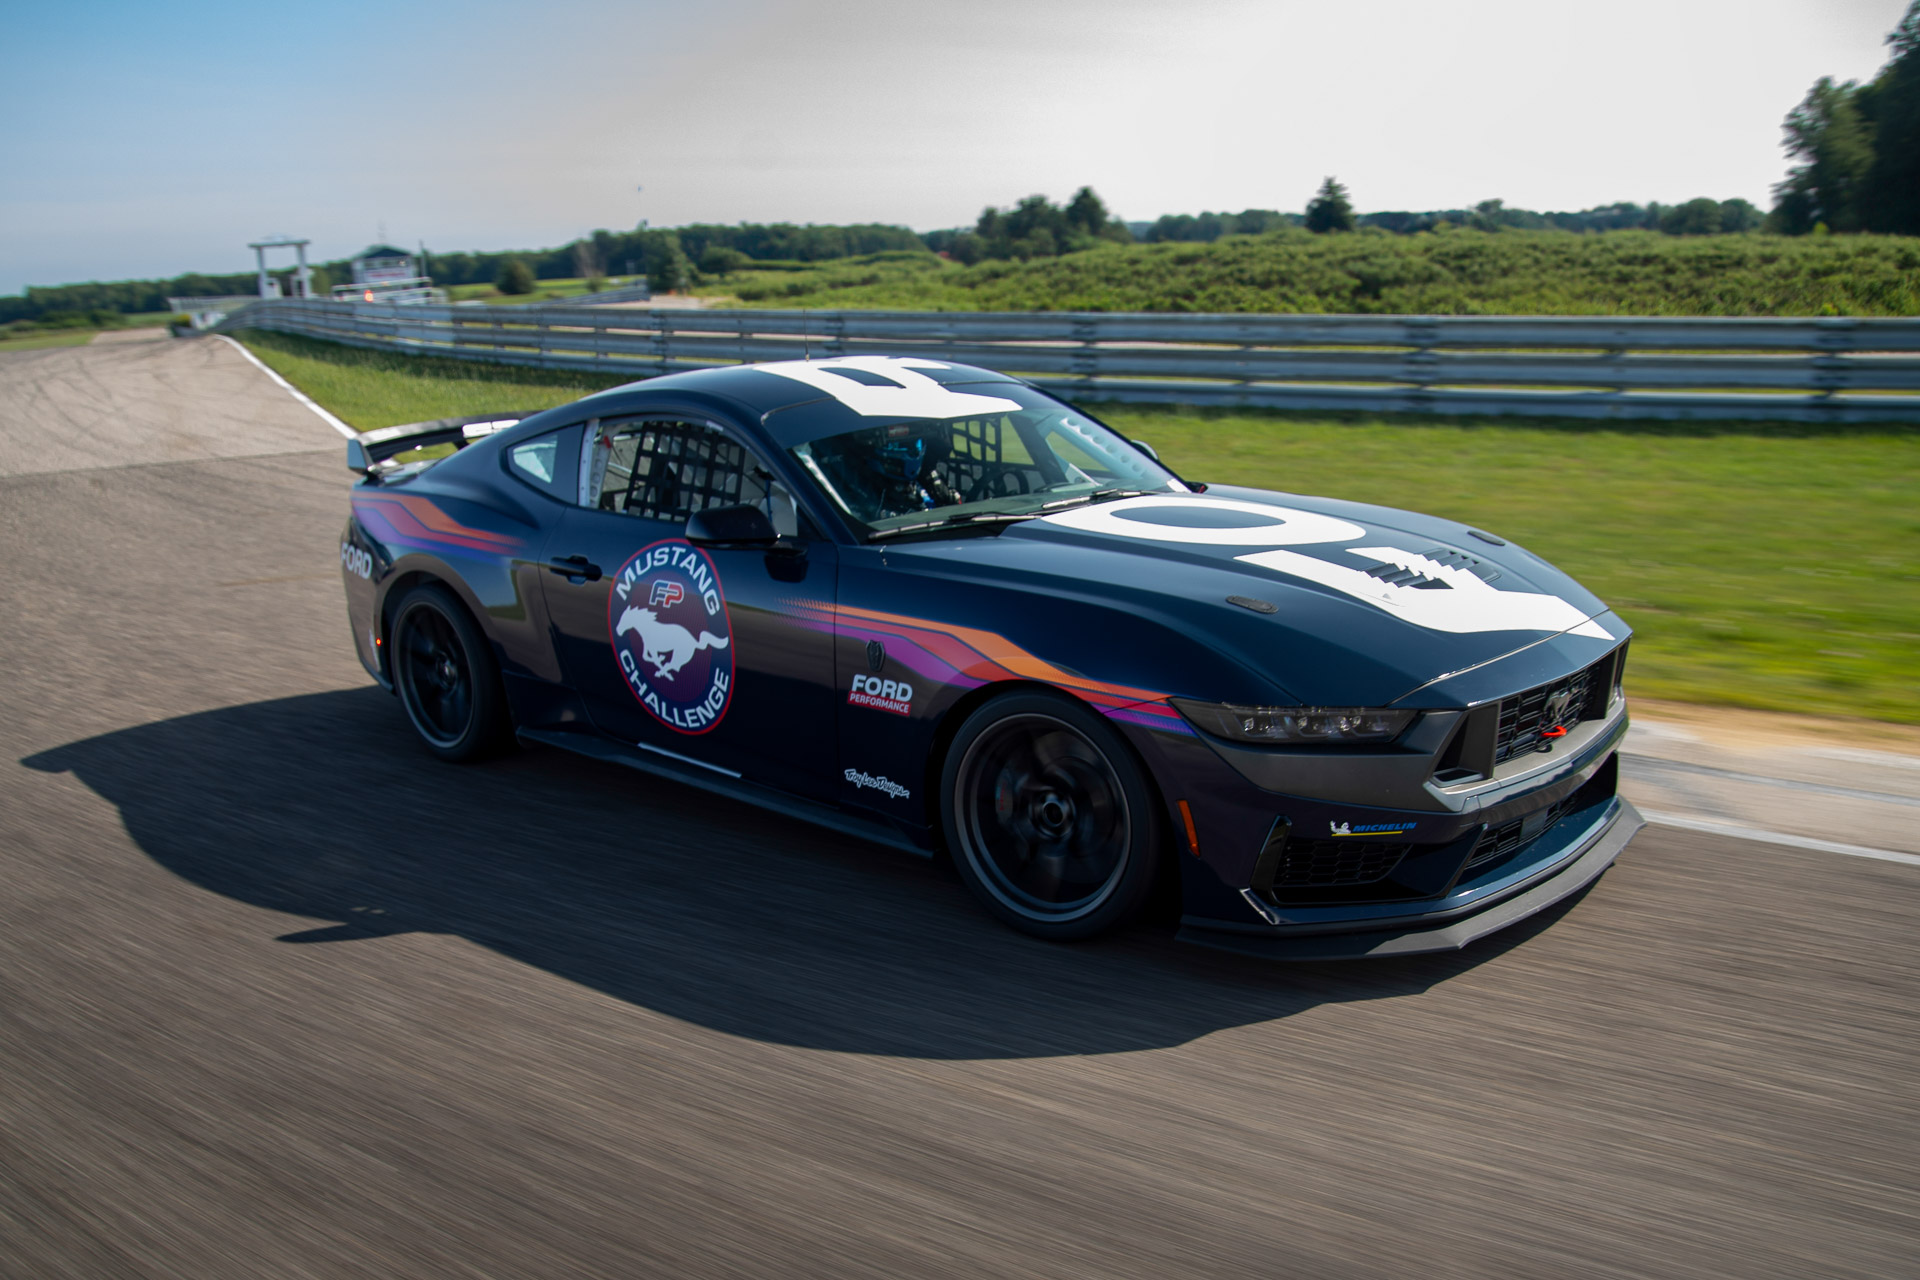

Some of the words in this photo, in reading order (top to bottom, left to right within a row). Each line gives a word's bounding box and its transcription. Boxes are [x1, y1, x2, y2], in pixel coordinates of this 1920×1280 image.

[341, 541, 372, 579] FORD
[616, 546, 720, 616] MUSTANG
[620, 649, 729, 728] CHALLENGE
[849, 692, 909, 713] PERFORMANCE
[851, 674, 913, 702] FORD
[1352, 822, 1417, 832] MICHELIN
